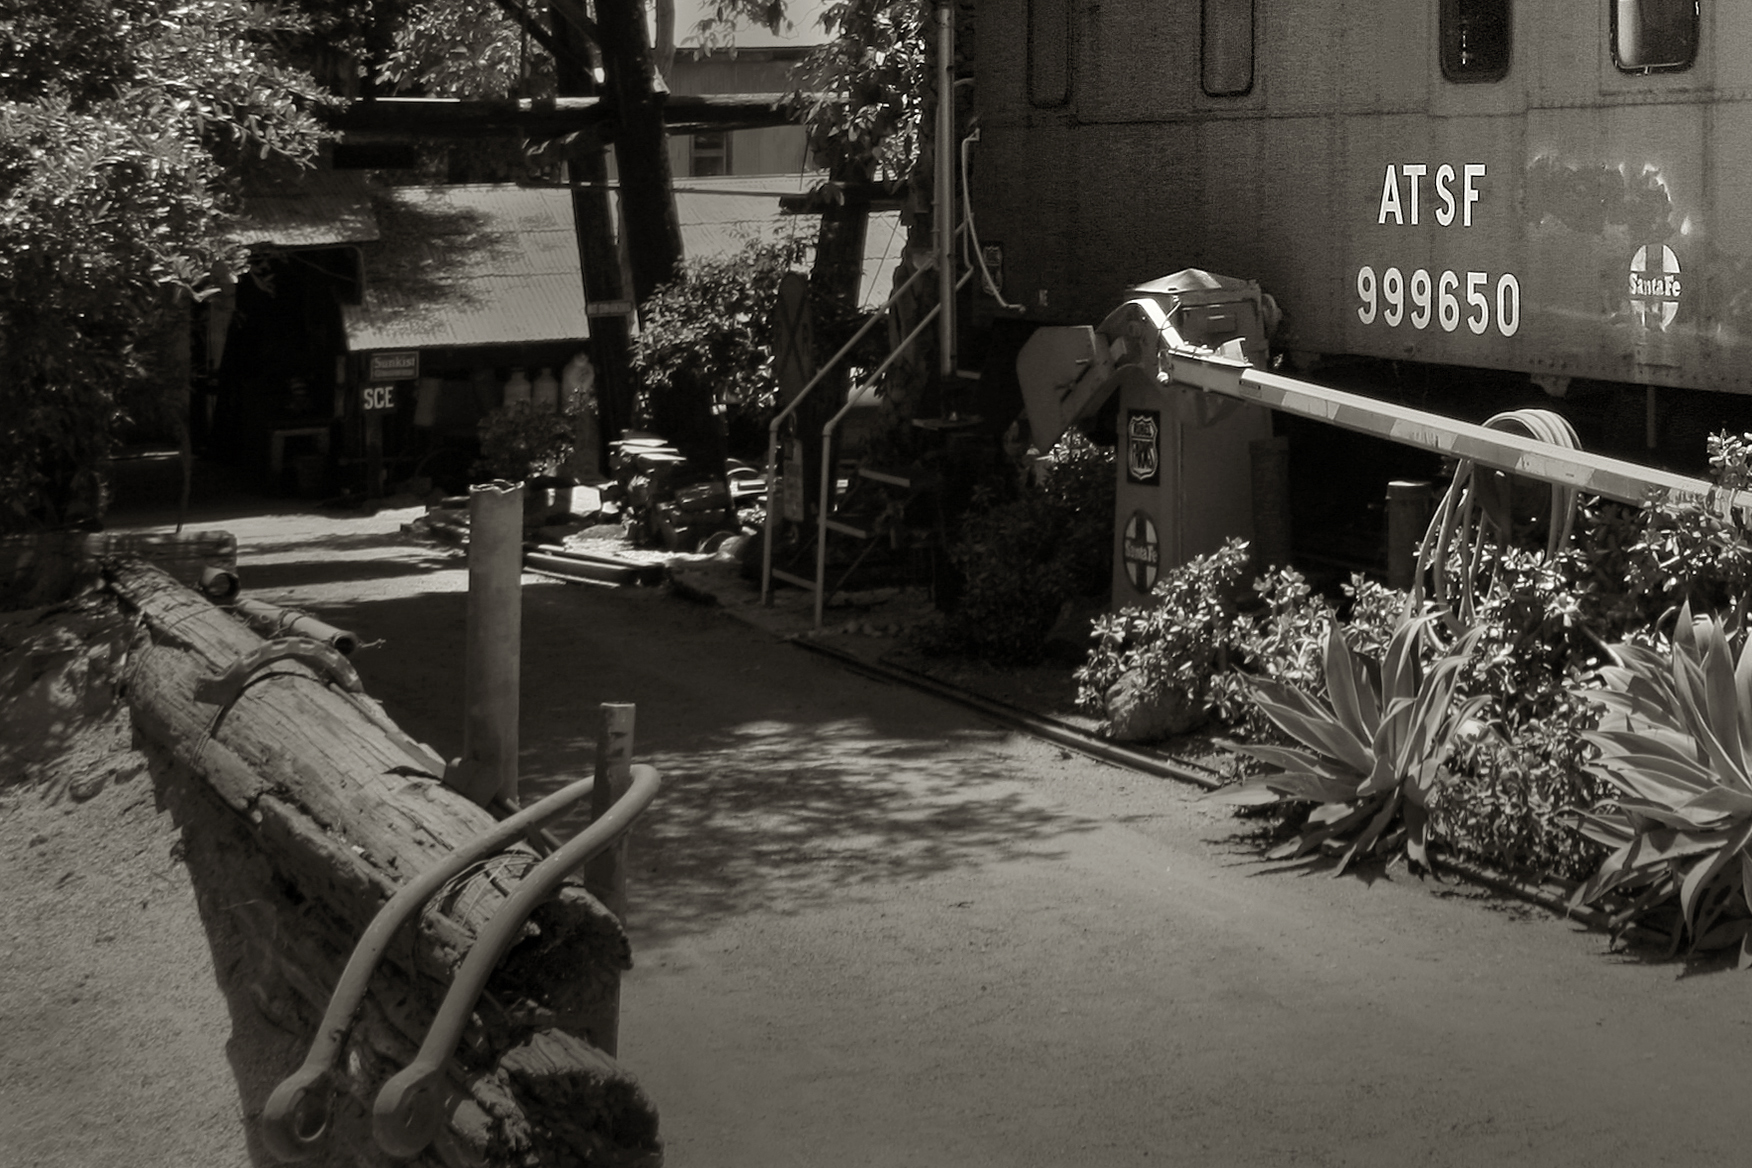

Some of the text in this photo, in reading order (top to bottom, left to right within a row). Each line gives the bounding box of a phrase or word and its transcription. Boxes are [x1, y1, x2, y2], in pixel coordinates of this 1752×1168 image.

[1378, 162, 1487, 227] ATSF
[1628, 272, 1682, 297] Santa Fe
[1356, 265, 1521, 338] 999650
[374, 355, 416, 369] Sunkist
[363, 386, 395, 410] SCE
